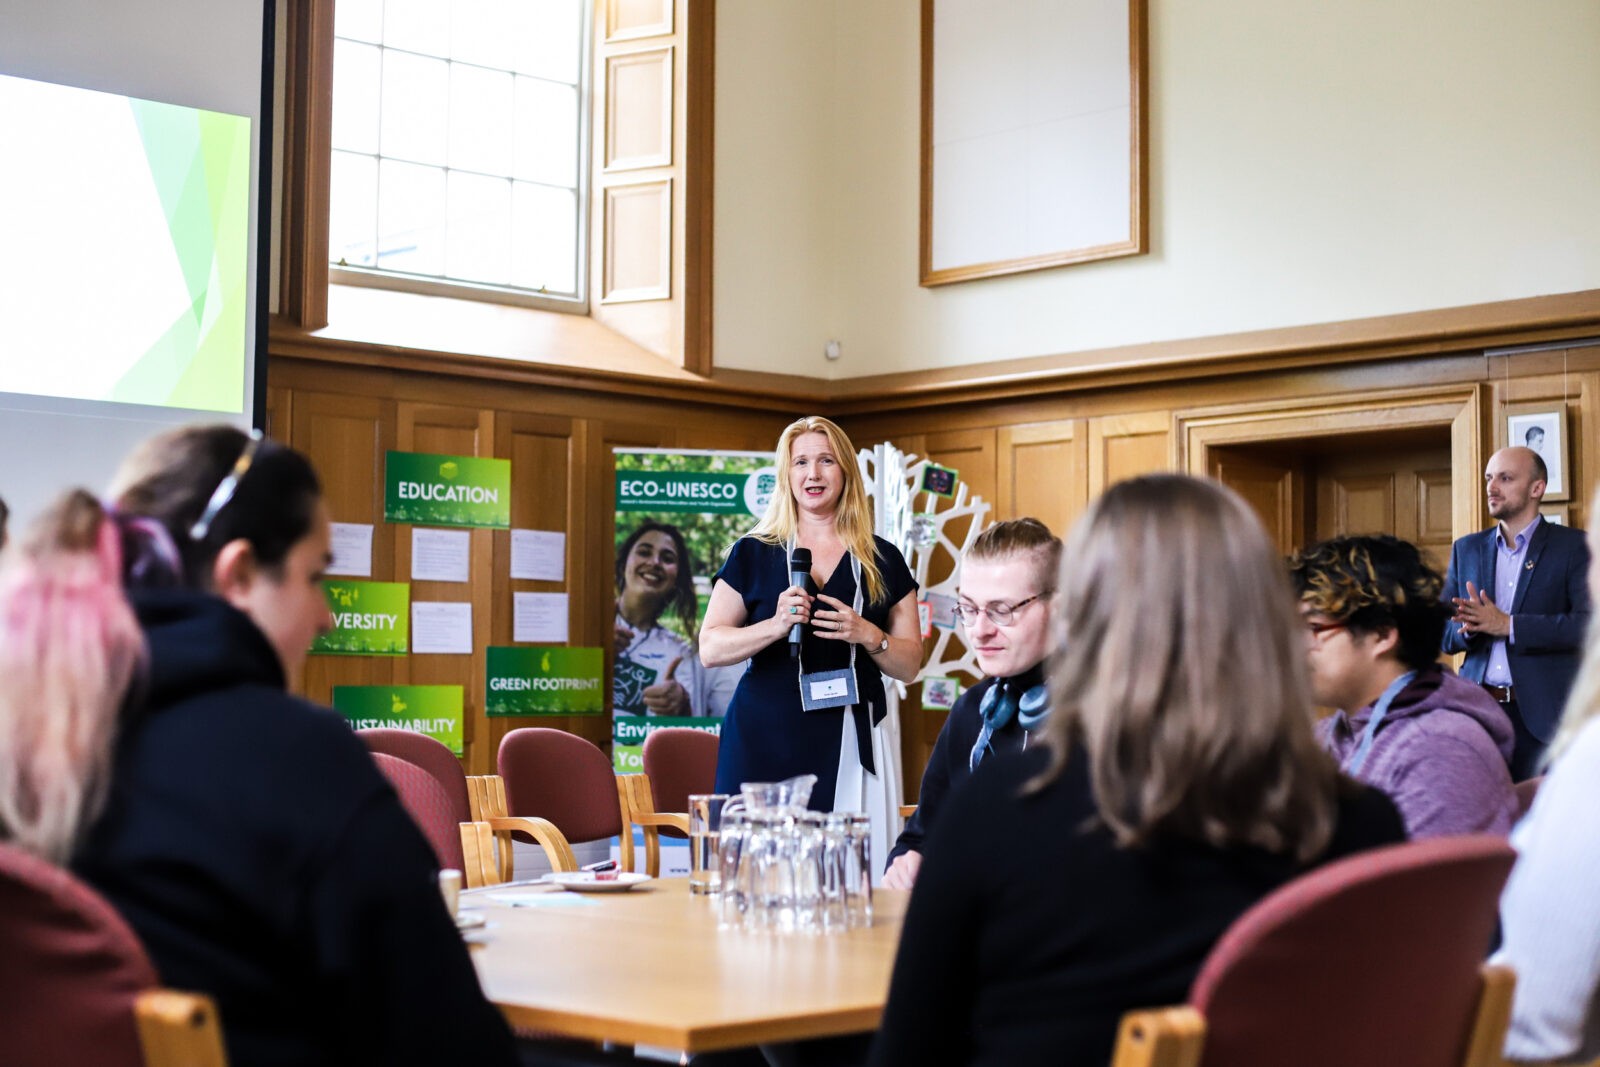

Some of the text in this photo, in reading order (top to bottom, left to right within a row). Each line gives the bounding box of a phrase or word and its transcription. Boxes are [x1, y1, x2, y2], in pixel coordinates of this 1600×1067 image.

[398, 481, 499, 504] EDUCATION
[620, 480, 737, 499] ECO-UNESCO
[329, 611, 398, 630] VERSITY
[489, 677, 599, 691] GREEN FOOTPRINT
[344, 718, 456, 733] USTAINABILITY
